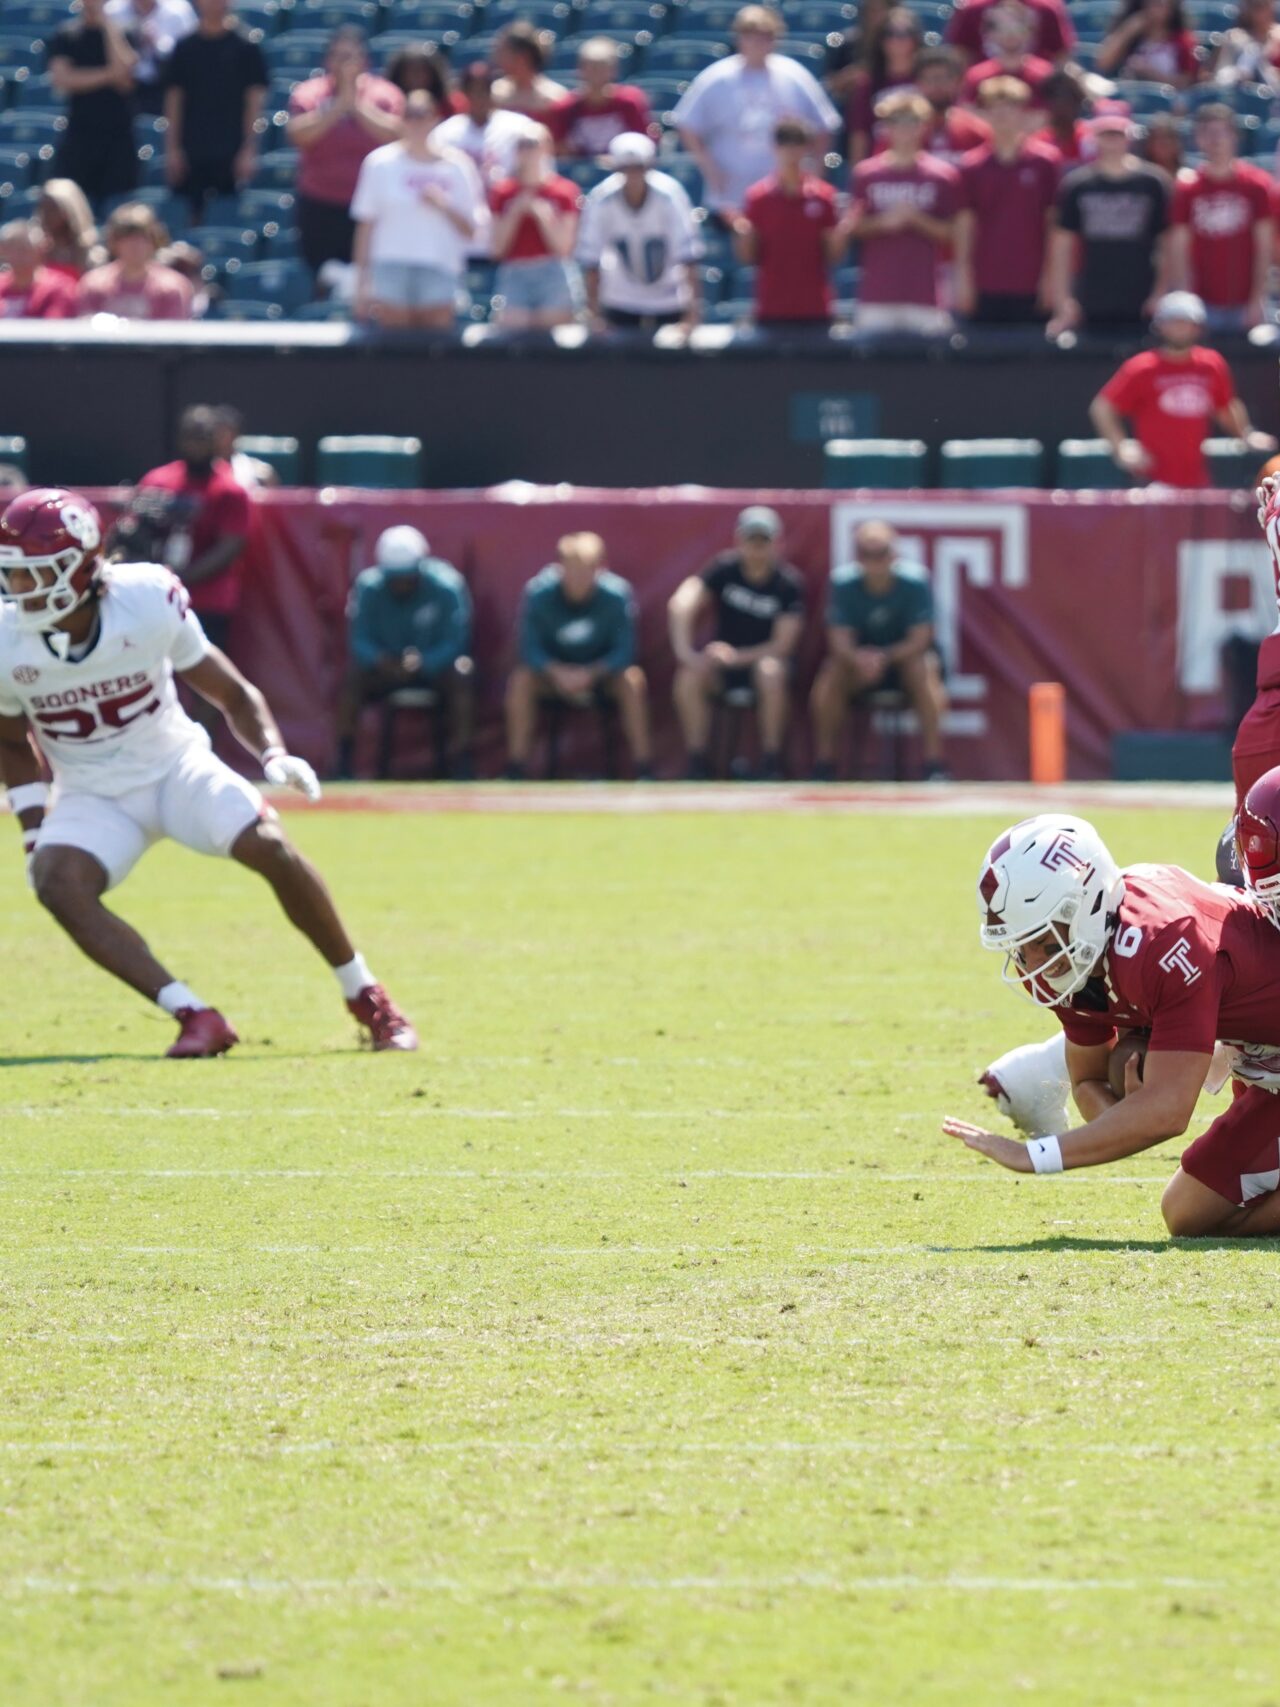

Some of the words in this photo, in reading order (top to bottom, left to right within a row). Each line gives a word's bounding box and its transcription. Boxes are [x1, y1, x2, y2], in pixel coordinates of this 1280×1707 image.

[1040, 833, 1096, 887] T
[1113, 923, 1143, 958] 6
[1158, 937, 1202, 986] T
